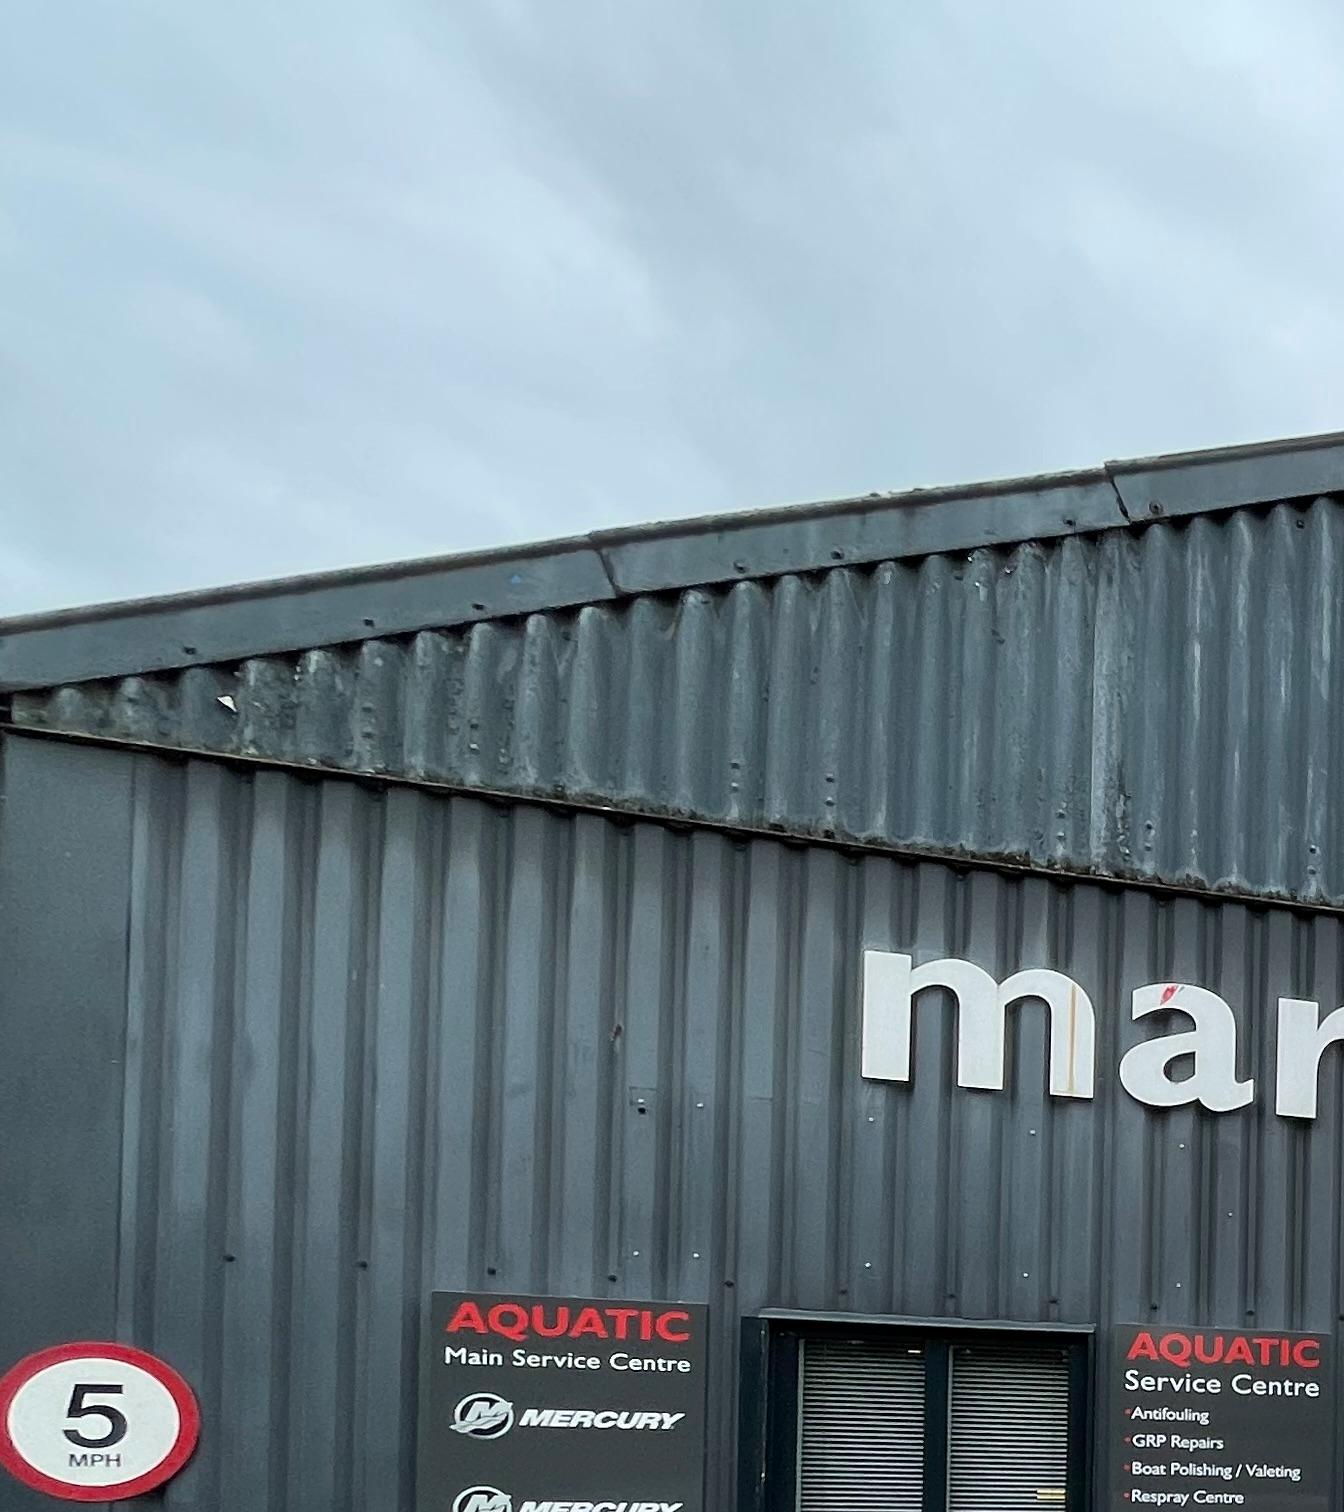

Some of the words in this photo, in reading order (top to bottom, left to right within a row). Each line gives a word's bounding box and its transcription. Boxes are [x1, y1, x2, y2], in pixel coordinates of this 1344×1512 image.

[447, 1301, 690, 1342] AQUATIC
[444, 1346, 503, 1366] Main
[512, 1349, 601, 1370] Service
[609, 1352, 691, 1373] Centre
[1126, 1332, 1320, 1368] AQUATIC
[1124, 1370, 1222, 1394] Service
[1231, 1374, 1320, 1397] Centre
[63, 1384, 128, 1449] 5
[519, 1408, 686, 1430] MERCURY
[1130, 1406, 1210, 1425] Antifouling
[1132, 1434, 1166, 1449] GRP
[1170, 1436, 1224, 1452] Repairs
[67, 1452, 122, 1468] MPH
[1131, 1462, 1166, 1477] Boat
[1170, 1463, 1232, 1480] Polishing
[1246, 1464, 1301, 1481] Valeting
[1131, 1490, 1189, 1506] Respray
[1193, 1491, 1244, 1505] Centre
